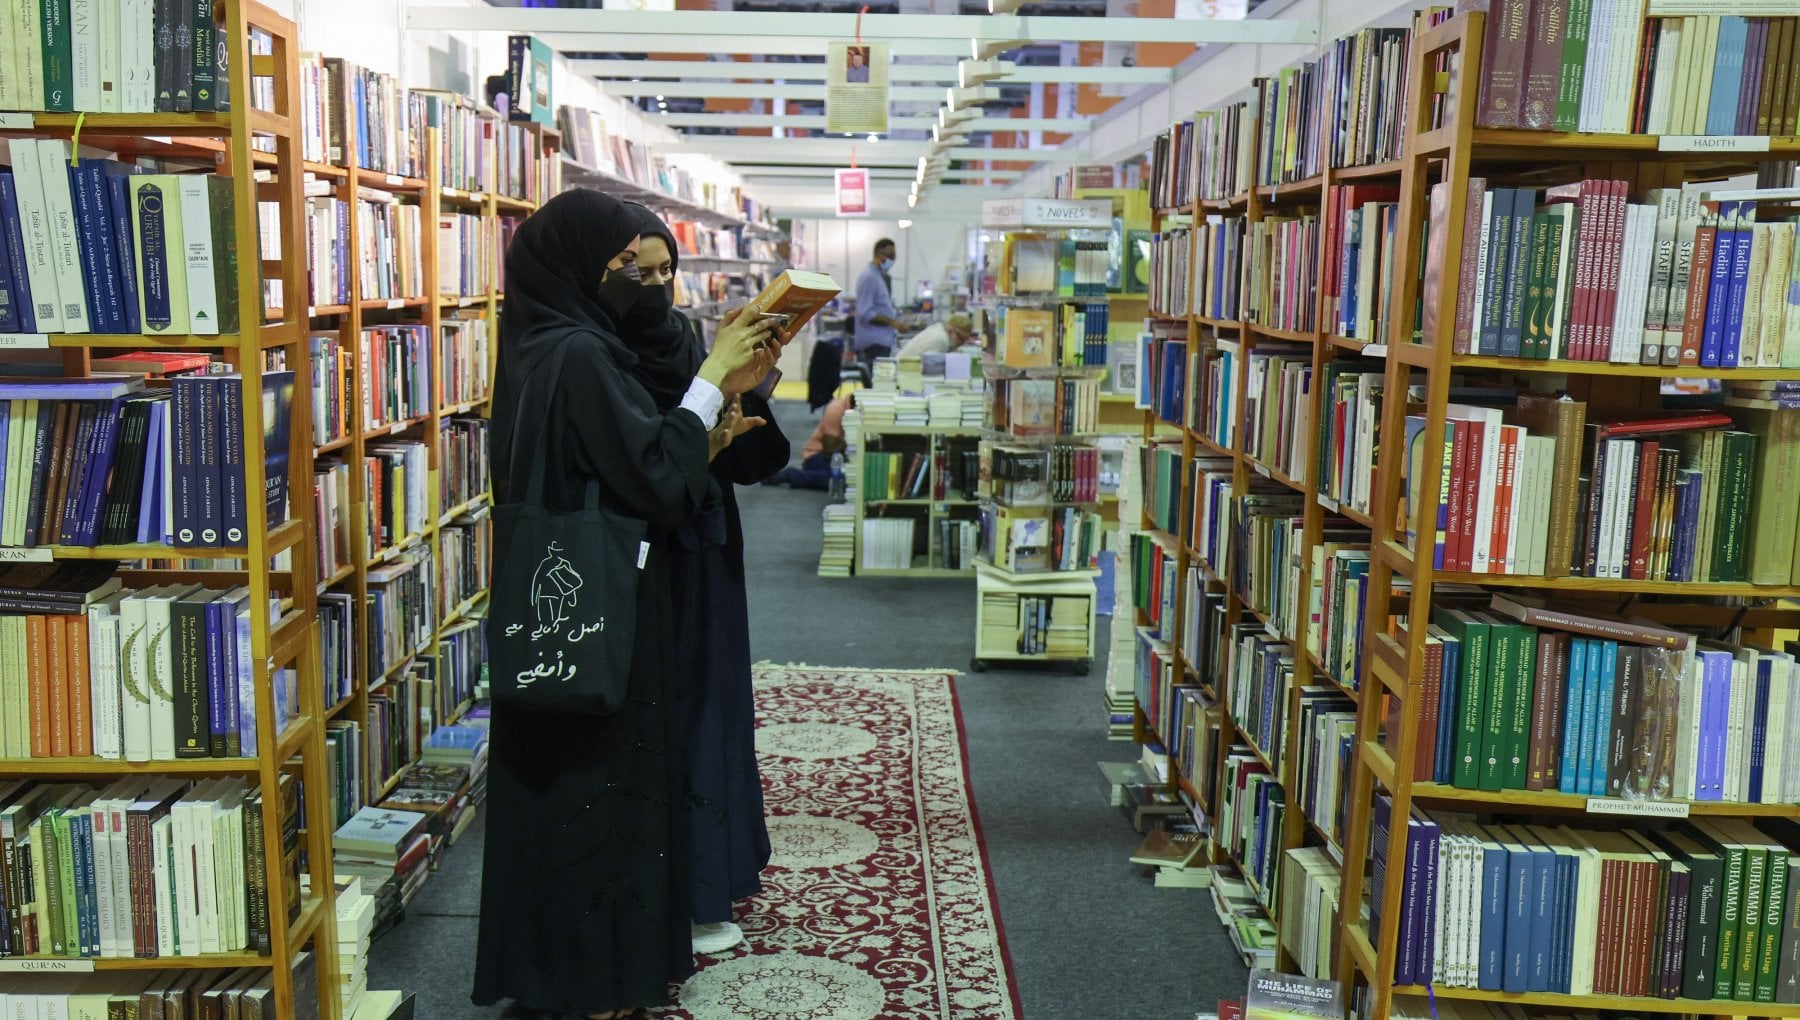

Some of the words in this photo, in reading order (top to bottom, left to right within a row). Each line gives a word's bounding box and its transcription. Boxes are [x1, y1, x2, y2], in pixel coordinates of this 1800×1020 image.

[46, 19, 54, 46] VERSION
[1693, 139, 1736, 147] HADITH
[1046, 207, 1084, 219] NOVELS
[1579, 194, 1591, 239] PROPHETIC
[1588, 194, 1600, 239] PROPHETIC
[1596, 195, 1608, 240] PROPHETIC
[1605, 196, 1617, 240] PROPHETIC
[1614, 196, 1626, 241] PROPHETIC
[1500, 215, 1510, 242] Spiritual
[1520, 216, 1530, 244] Spiritual
[1537, 223, 1548, 243] Daily
[1552, 223, 1562, 244] Daily
[1478, 240, 1488, 276] Ahadith
[1497, 244, 1508, 272] Teachings
[1517, 246, 1528, 274] Teachings
[1535, 245, 1545, 278] Wisdom
[1697, 232, 1711, 264] Hadith
[1715, 238, 1731, 278] Hadith
[1735, 238, 1750, 278] Hadith
[1550, 246, 1560, 278] Wisdom
[1575, 240, 1587, 288] MATRIMONY
[1583, 240, 1595, 289] MATRIMONY
[1591, 241, 1604, 290] MATRIMONY
[1600, 241, 1613, 290] MATRIMONY
[1609, 242, 1622, 291] MATRIMONY
[1492, 294, 1502, 321] Prophet
[1512, 296, 1522, 323] Prophet
[1569, 324, 1577, 344] KHAN
[1585, 325, 1593, 345] KHAN
[1594, 325, 1602, 346] KHAN
[1602, 326, 1610, 346] KHAN
[1442, 442, 1453, 466] FAKE
[1498, 452, 1506, 468] NOBLE
[1507, 453, 1515, 468] NOBLE
[1508, 444, 1516, 453] THE
[1439, 468, 1451, 504] PEARLS
[1452, 476, 1461, 489] The
[1467, 479, 1476, 492] The
[1496, 468, 1504, 486] WORDS
[1505, 469, 1513, 487] WORDS
[1448, 490, 1459, 515] Goodly
[1463, 494, 1474, 518] Goodly
[1449, 516, 1458, 533] Word
[1463, 519, 1472, 536] Word
[1535, 614, 1569, 626] MUHAMMAD
[1574, 622, 1597, 631] PORTRAIT
[1605, 627, 1634, 636] PERFECTION
[1475, 635, 1483, 667] MUHAMMAD
[1500, 637, 1508, 669] MUHAMMAD
[1522, 637, 1530, 668] MUHAMMAD
[1542, 643, 1550, 676] MUHAMMAD
[1473, 669, 1481, 699] MESSENGER
[1498, 670, 1506, 700] MESSENGER
[1520, 670, 1528, 699] MESSENGER
[1470, 708, 1478, 725] ALLAH
[1536, 711, 1544, 739] PERFECTION
[1592, 802, 1631, 810] PROPHET
[1633, 804, 1685, 814] MUHAMMAD
[44, 822, 52, 834] THE
[84, 819, 92, 864] INTRODUCTION
[44, 835, 54, 859] QUR'AN
[72, 821, 80, 866] INTRODUCTION
[98, 850, 107, 893] SCRIPTURAL
[114, 850, 124, 894] SCRIPTURAL
[1725, 851, 1743, 921] MUHAMMAD
[1745, 856, 1764, 925] MUHAMMAD
[1767, 855, 1786, 925] MUHAMMAD
[101, 896, 109, 930] POLEMICS
[1699, 884, 1710, 924] Muhammad
[1723, 930, 1732, 952] Martin
[1744, 931, 1754, 952] Martin
[1765, 934, 1775, 954] Martin
[21, 961, 66, 970] QUR'AN
[1720, 952, 1731, 970] Lings
[1742, 952, 1753, 971] Lings
[1762, 954, 1773, 974] Lings
[1257, 978, 1281, 986] THE
[1285, 983, 1312, 991] LIFE
[1257, 983, 1333, 999] MUHAMMAD
